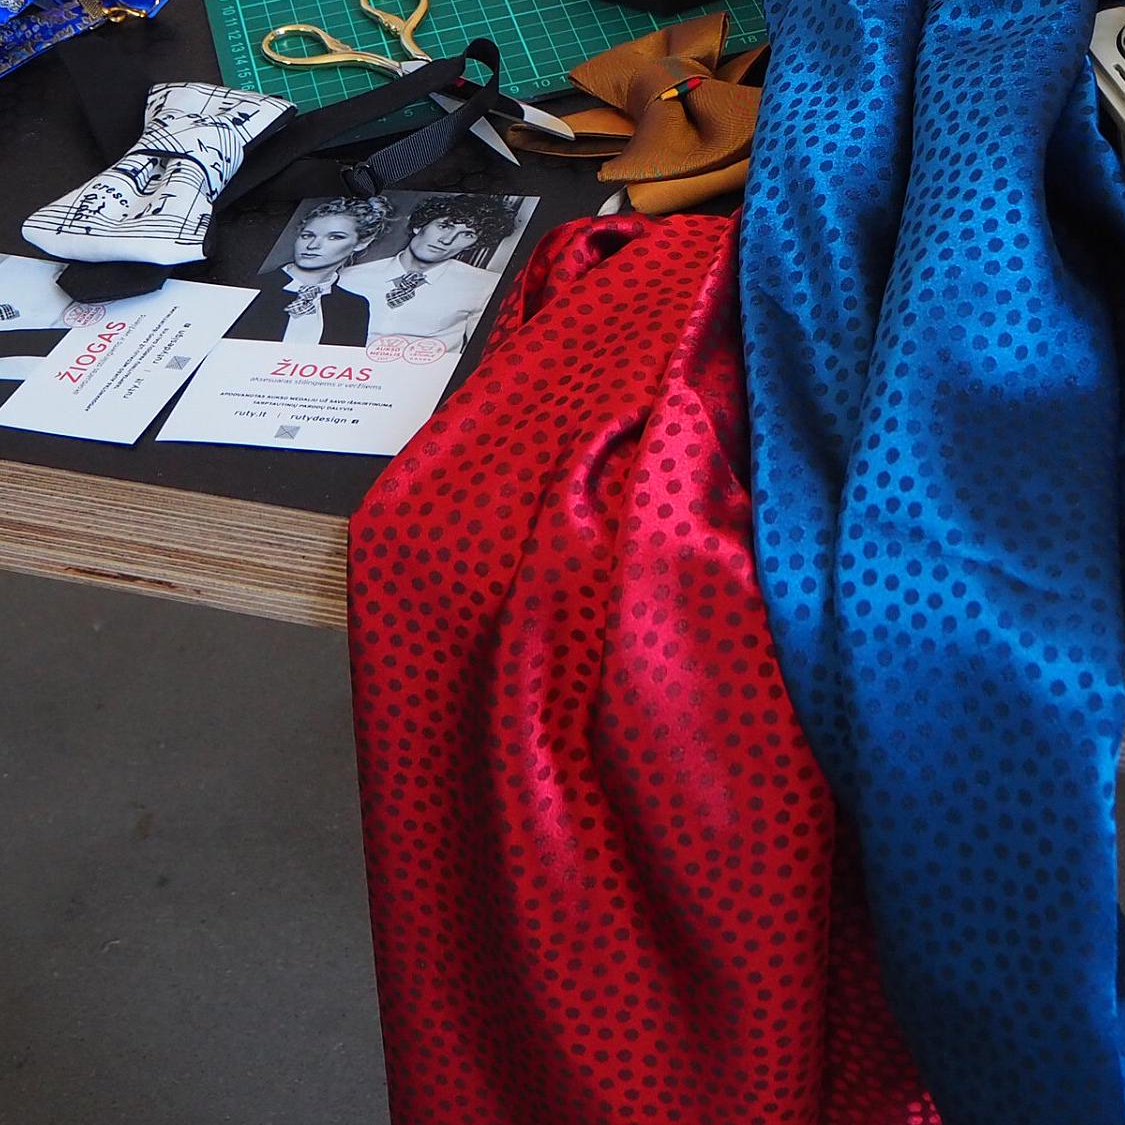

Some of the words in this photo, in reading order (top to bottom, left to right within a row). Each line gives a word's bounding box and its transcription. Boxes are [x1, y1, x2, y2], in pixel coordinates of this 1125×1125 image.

[222, 6, 235, 16] 10
[224, 17, 238, 27] 11
[227, 30, 241, 41] 12
[740, 35, 757, 44] 18
[230, 42, 245, 53] 13
[234, 54, 247, 65] 14
[238, 66, 252, 78] 15
[240, 80, 255, 91] 16
[510, 86, 520, 94] 9
[532, 80, 550, 88] 10
[92, 183, 129, 208] cresc.
[55, 321, 127, 383] ŽIOGAS
[270, 358, 373, 382] ŽIOGAS
[234, 410, 267, 418] ruty.lt
[290, 414, 347, 424] rutydesign
